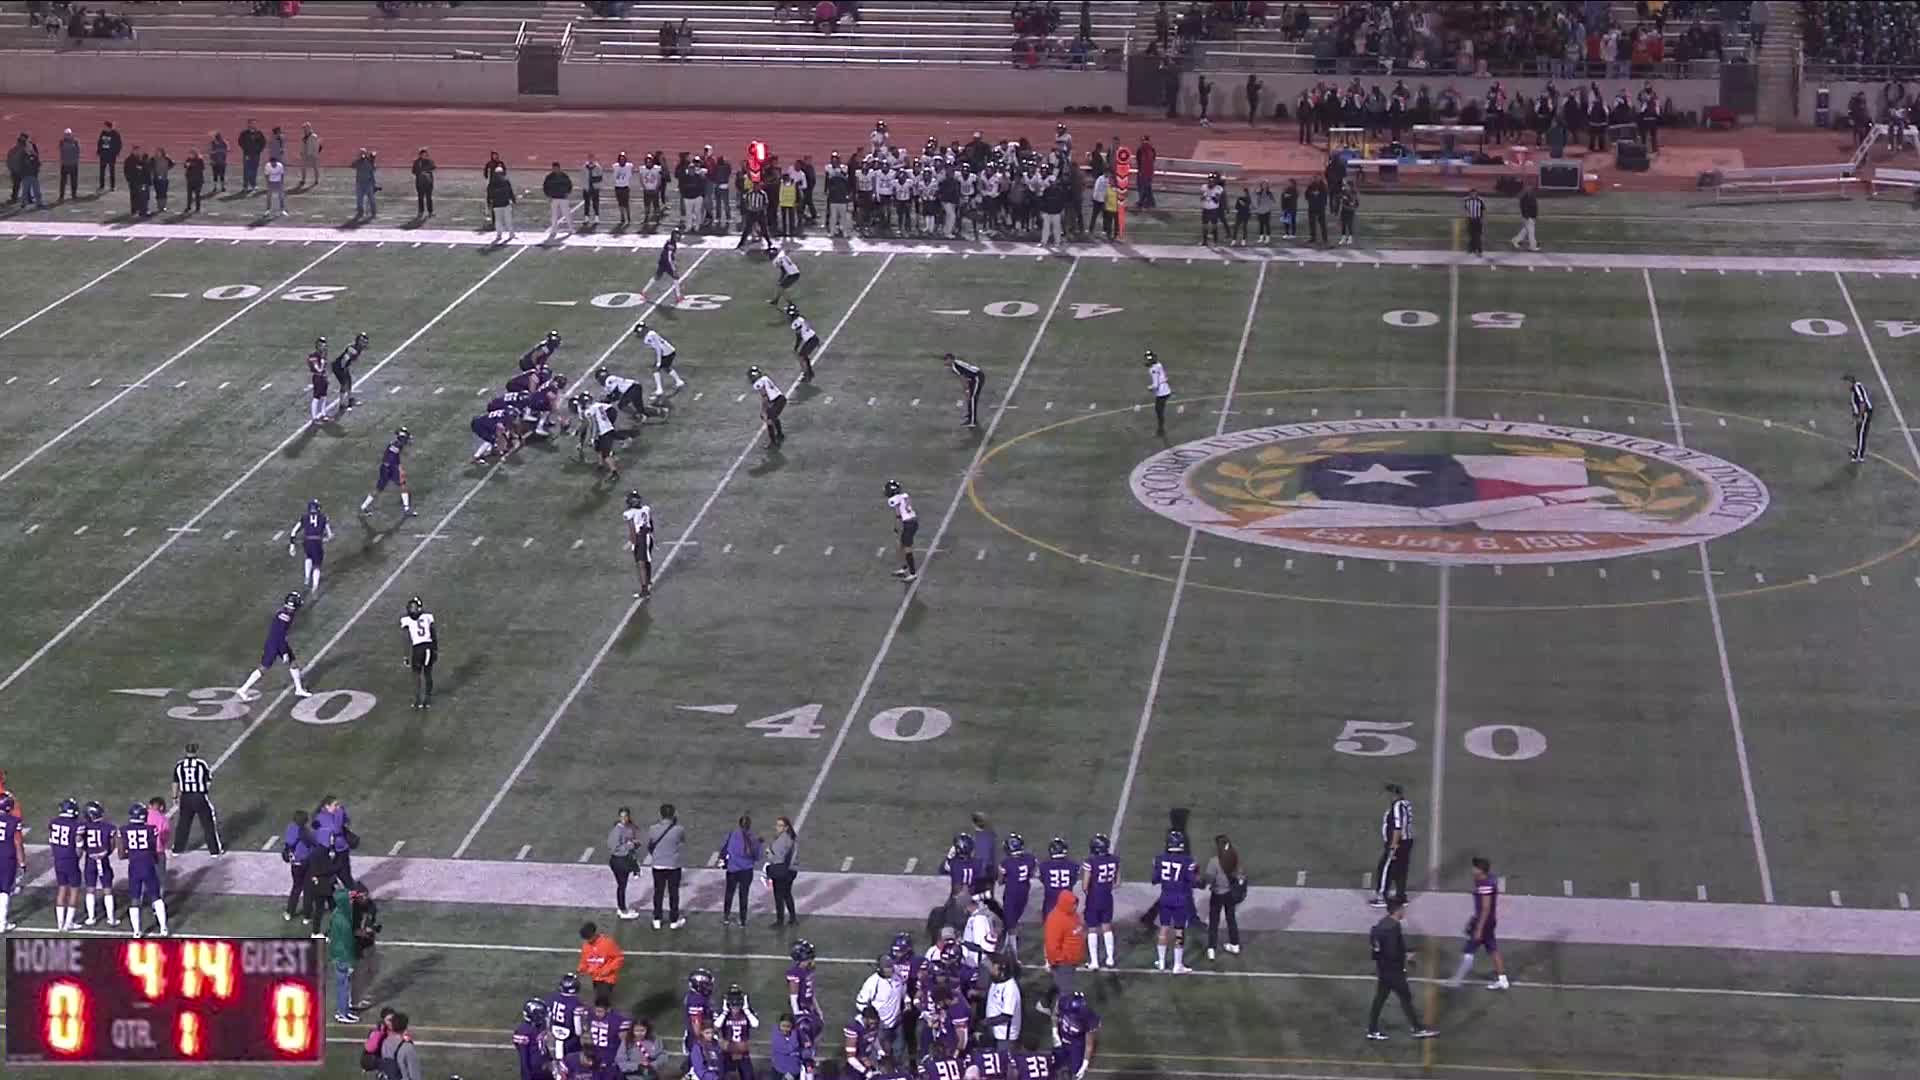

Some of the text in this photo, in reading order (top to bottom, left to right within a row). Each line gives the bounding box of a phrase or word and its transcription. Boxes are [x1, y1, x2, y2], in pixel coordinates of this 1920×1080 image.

[1547, 427, 1704, 461] SCHOOL
[417, 619, 426, 637] 5
[51, 824, 69, 845] 28
[87, 829, 101, 847] 21
[127, 829, 148, 849] 83
[963, 868, 973, 885] 11
[1049, 869, 1070, 887] 35
[1098, 863, 1116, 883] 23
[1161, 861, 1181, 881] 27
[935, 1060, 960, 1080] 90
[982, 1053, 1000, 1075] 31
[1025, 1056, 1049, 1079] 33
